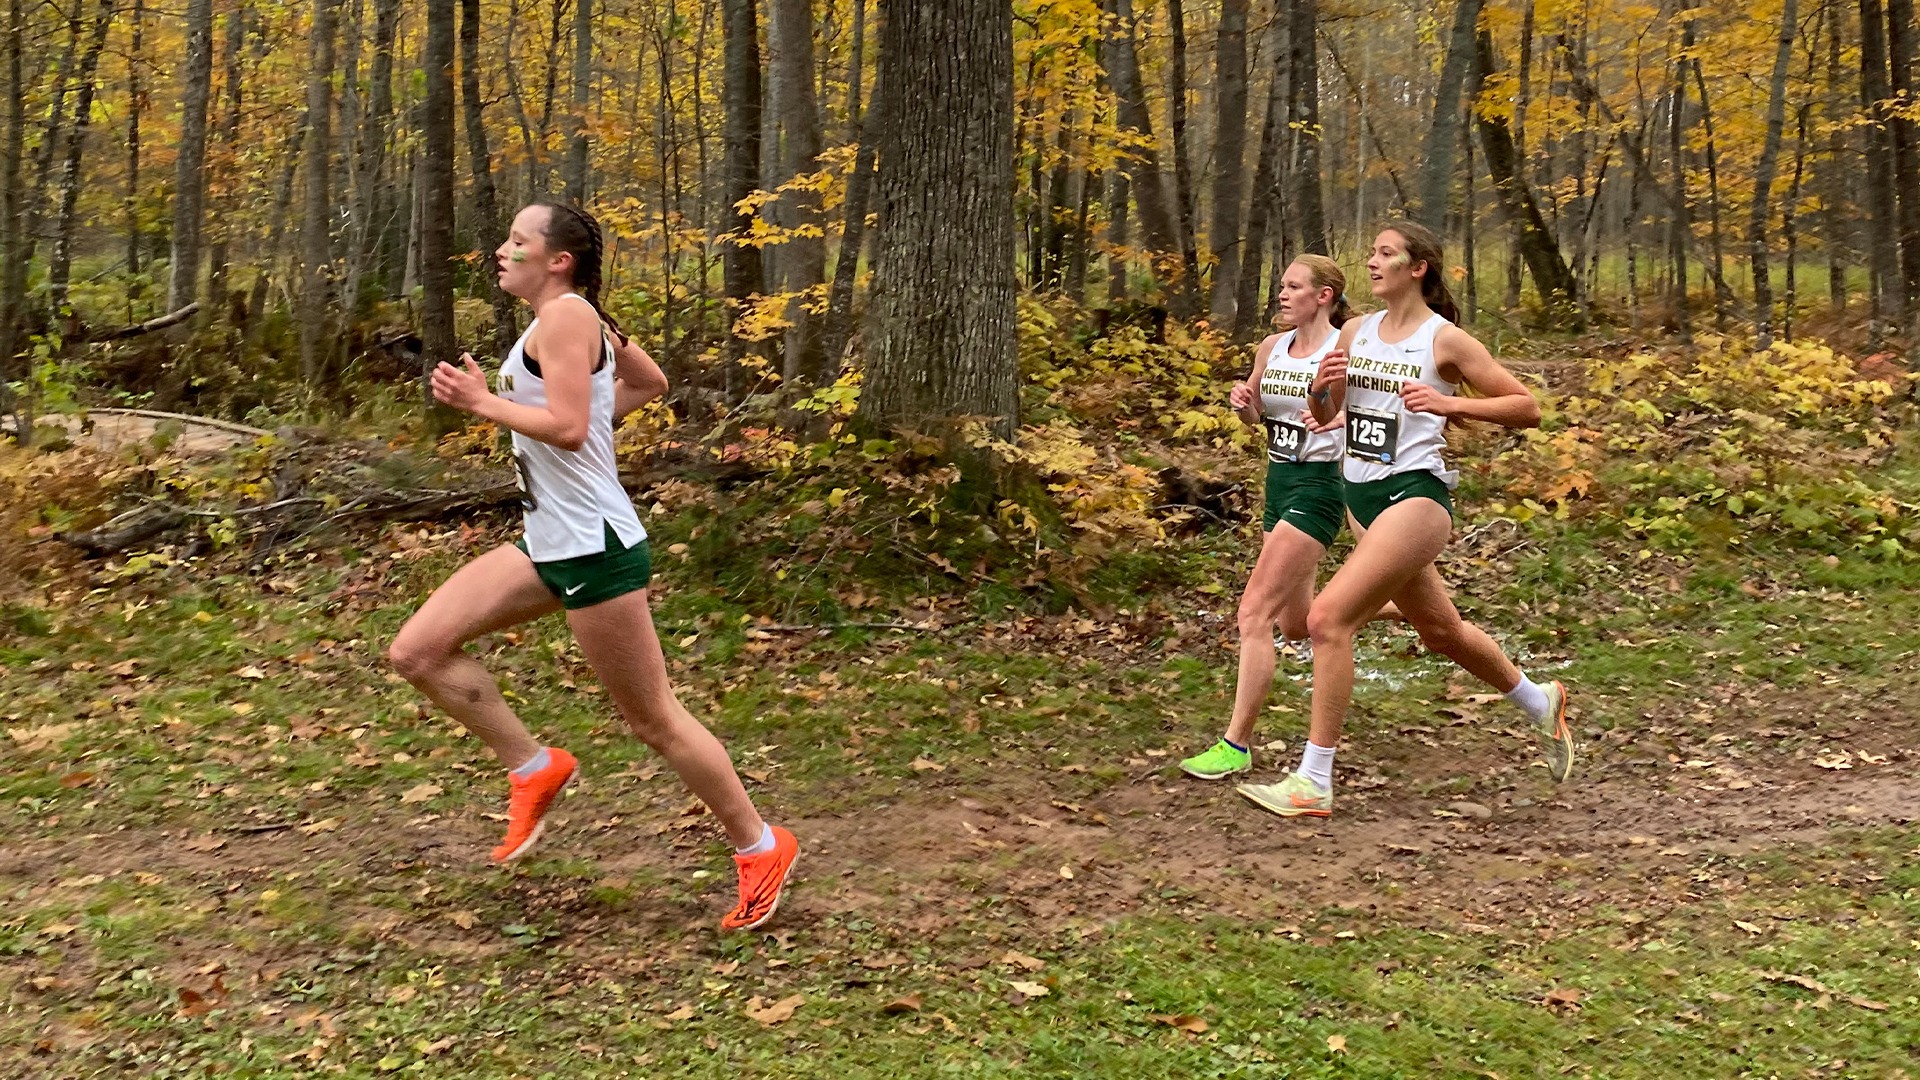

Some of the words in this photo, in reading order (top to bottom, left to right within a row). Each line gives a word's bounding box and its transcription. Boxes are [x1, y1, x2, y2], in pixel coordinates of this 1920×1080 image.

[1264, 368, 1314, 383] NORTHER
[1349, 356, 1422, 379] NORTHERN
[1261, 383, 1306, 398] MICHIGA
[1347, 373, 1405, 394] MICHIGA
[1273, 424, 1299, 450] 134
[1351, 417, 1386, 447] 125
